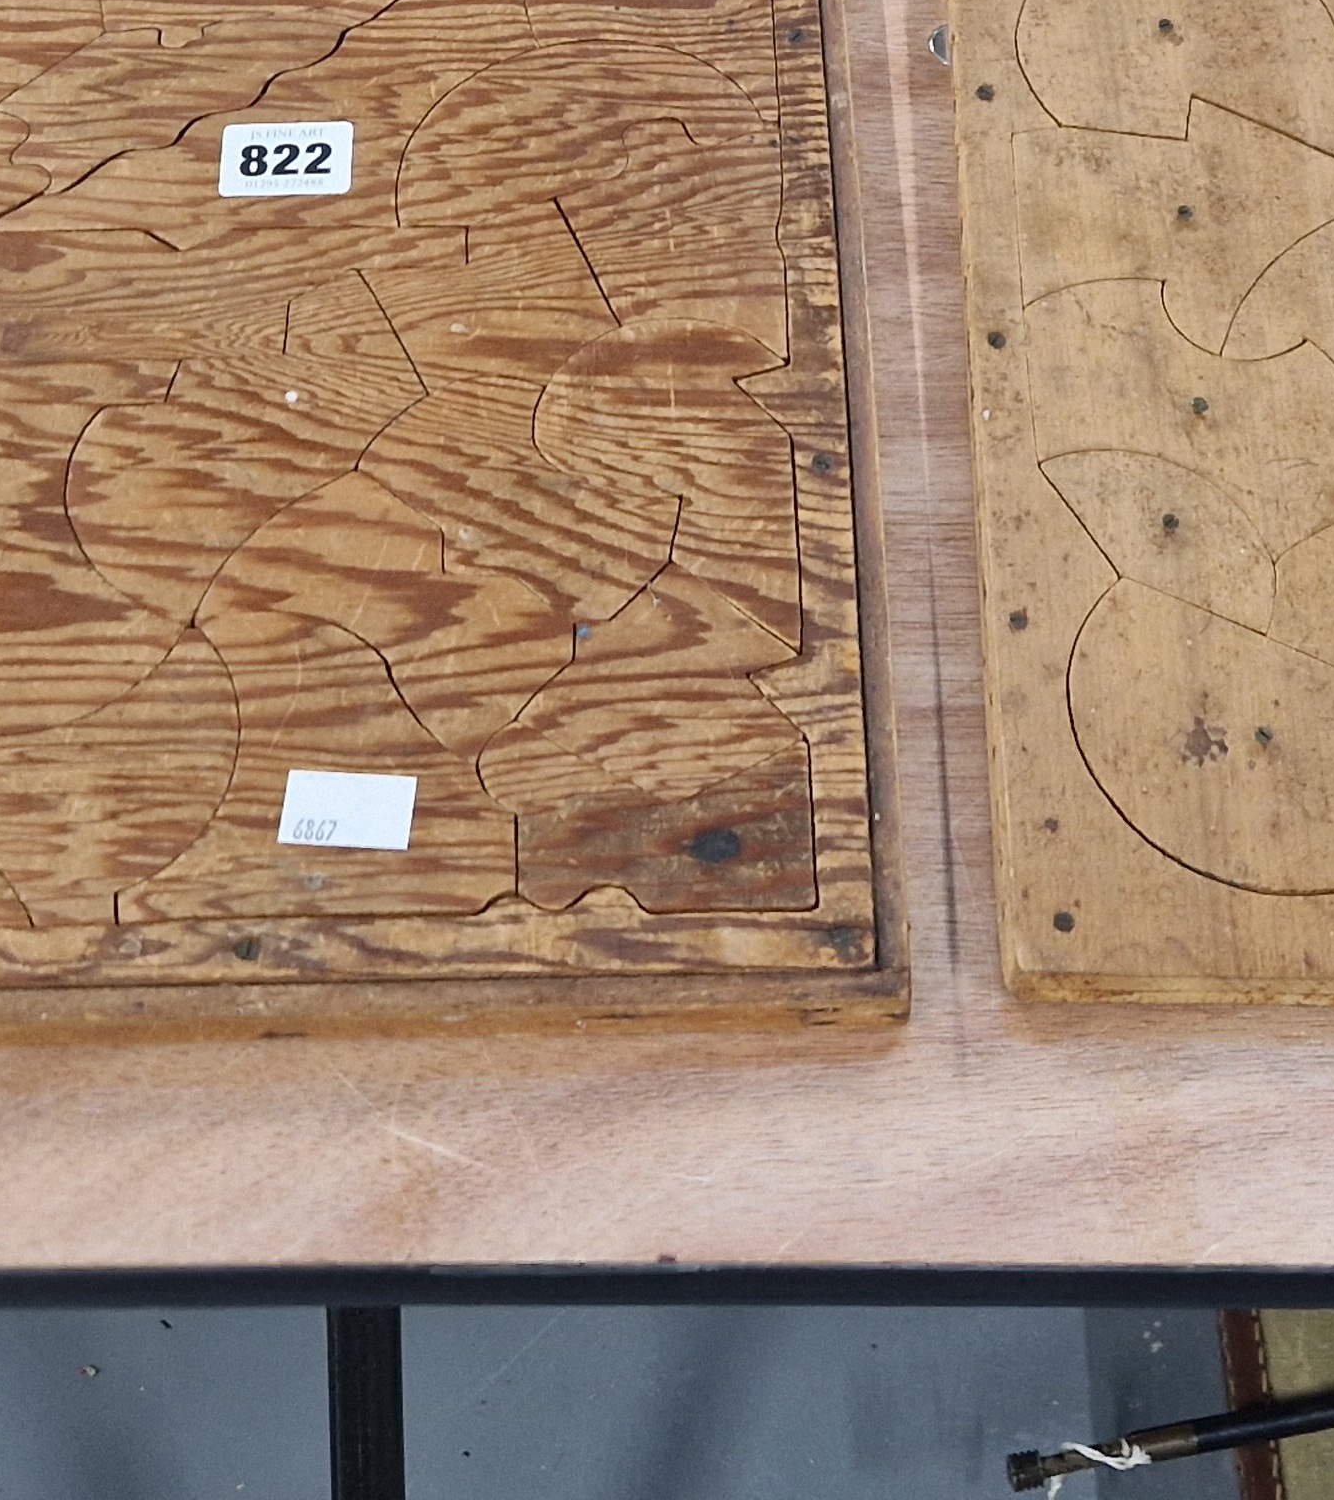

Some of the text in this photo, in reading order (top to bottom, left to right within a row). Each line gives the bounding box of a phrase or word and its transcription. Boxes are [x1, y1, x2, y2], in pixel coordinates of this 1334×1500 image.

[265, 128, 294, 139] FINE
[298, 127, 326, 138] ART
[239, 142, 333, 177] 822
[292, 818, 339, 843] 6867
